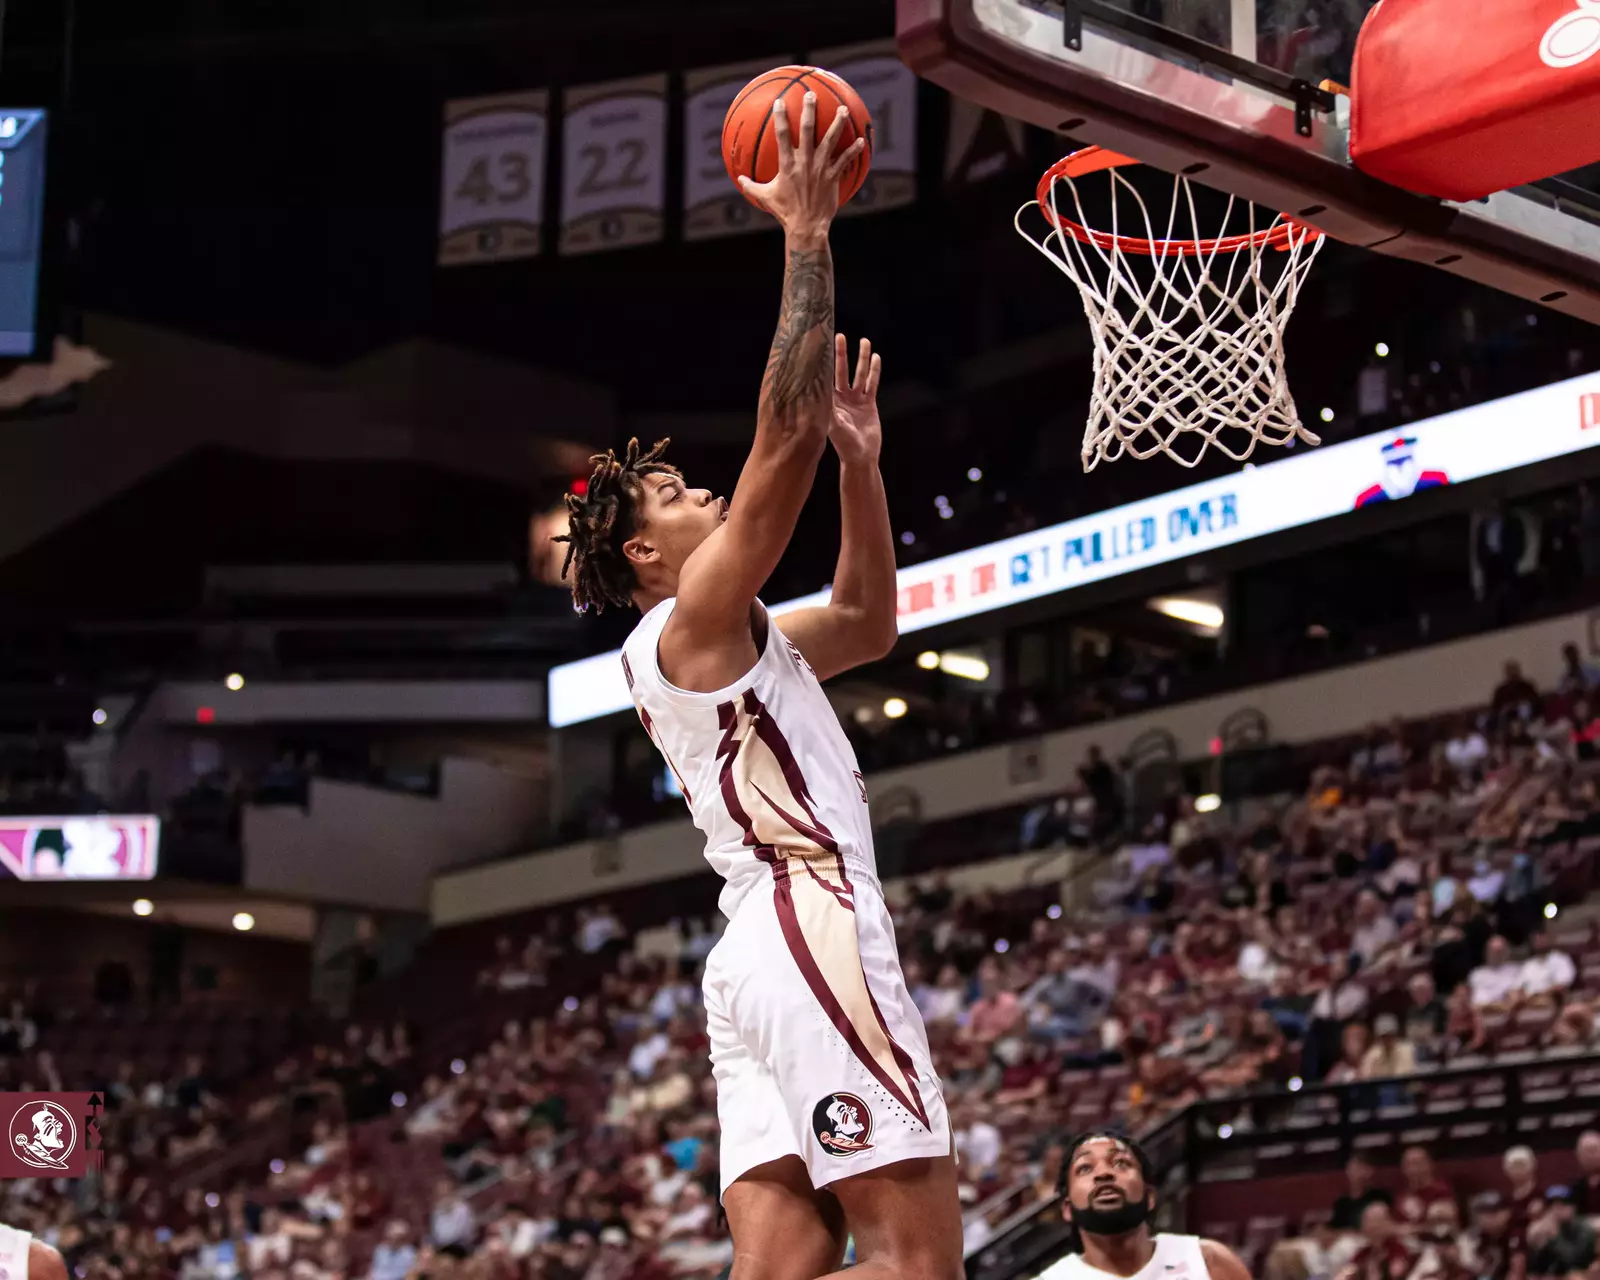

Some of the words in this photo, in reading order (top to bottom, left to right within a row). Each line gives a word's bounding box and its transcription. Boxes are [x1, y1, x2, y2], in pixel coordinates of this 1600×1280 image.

[454, 150, 531, 206] 43
[577, 138, 650, 197] 22
[1062, 516, 1157, 572] PULLED
[1168, 493, 1239, 543] OVER
